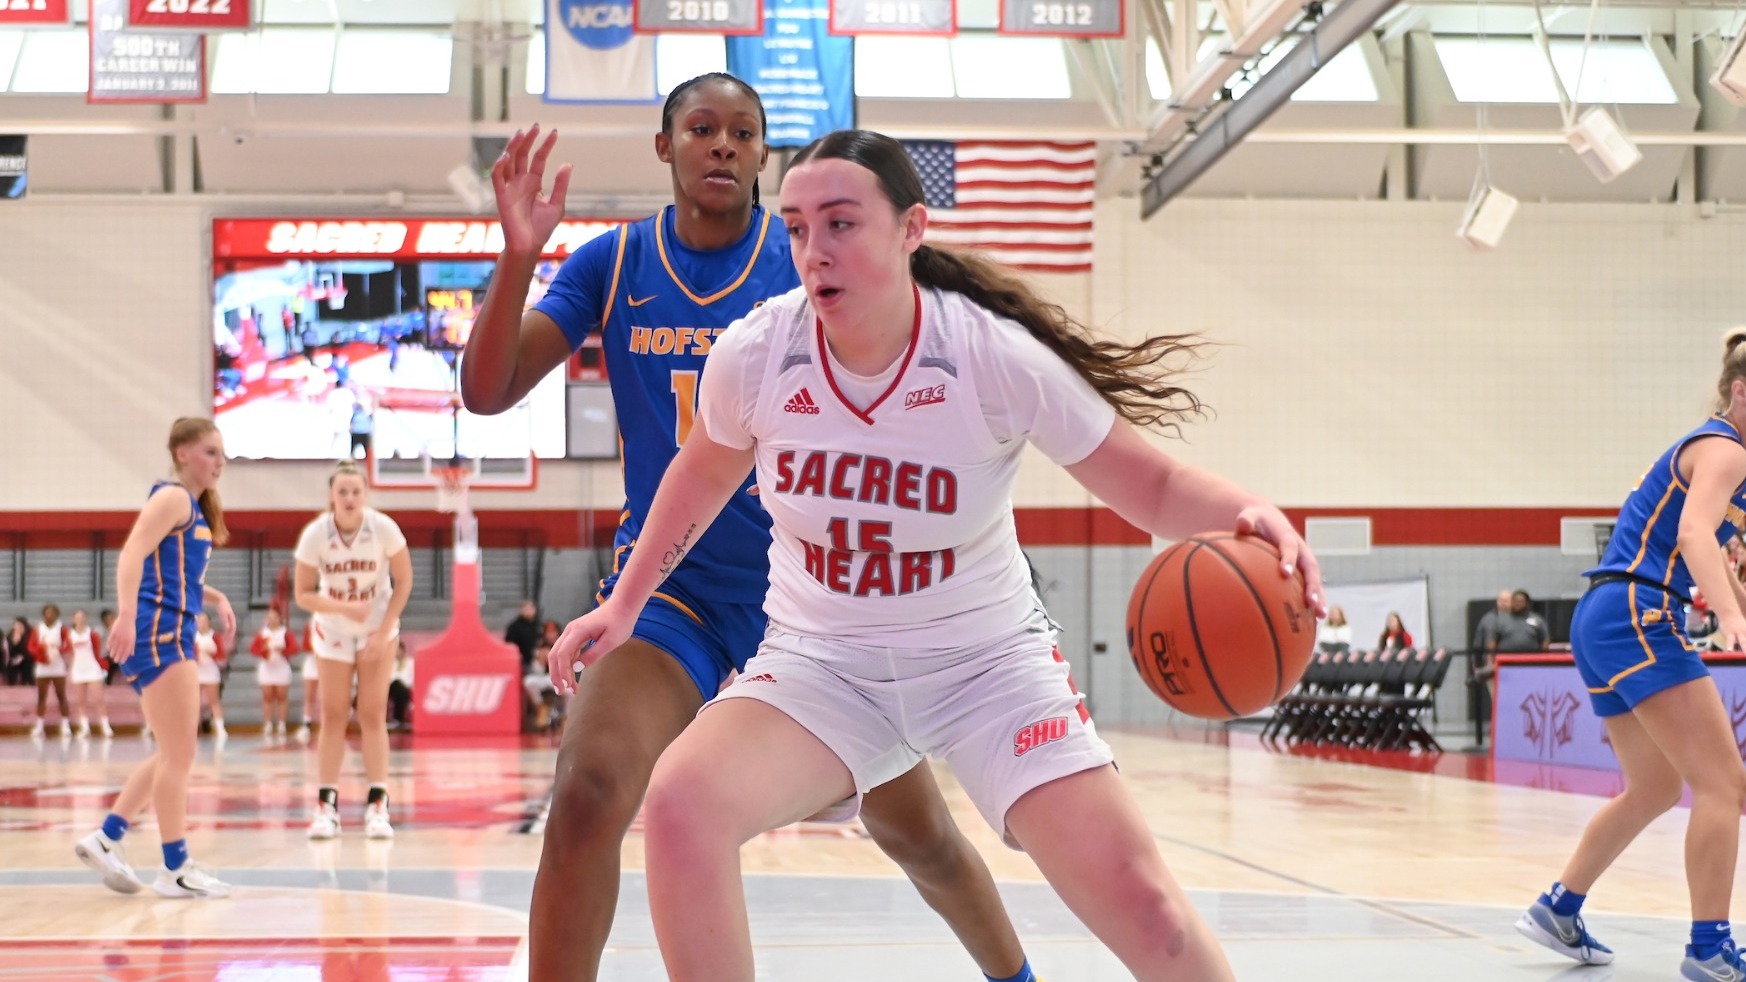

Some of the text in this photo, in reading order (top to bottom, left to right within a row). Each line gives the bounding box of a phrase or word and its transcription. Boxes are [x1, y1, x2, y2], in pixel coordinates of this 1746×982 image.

[667, 2, 729, 21] 2010
[864, 3, 921, 24] 2011
[1031, 4, 1092, 25] 2012
[96, 58, 197, 73] CAREER WIN
[95, 78, 154, 91] JANUARY
[267, 222, 408, 253] SACRED
[784, 403, 820, 415] adidas
[774, 450, 958, 516] SACRED
[826, 517, 894, 553] 15
[325, 559, 377, 574] SACRED
[423, 674, 514, 716] SHU
[1014, 717, 1068, 757] SHU
